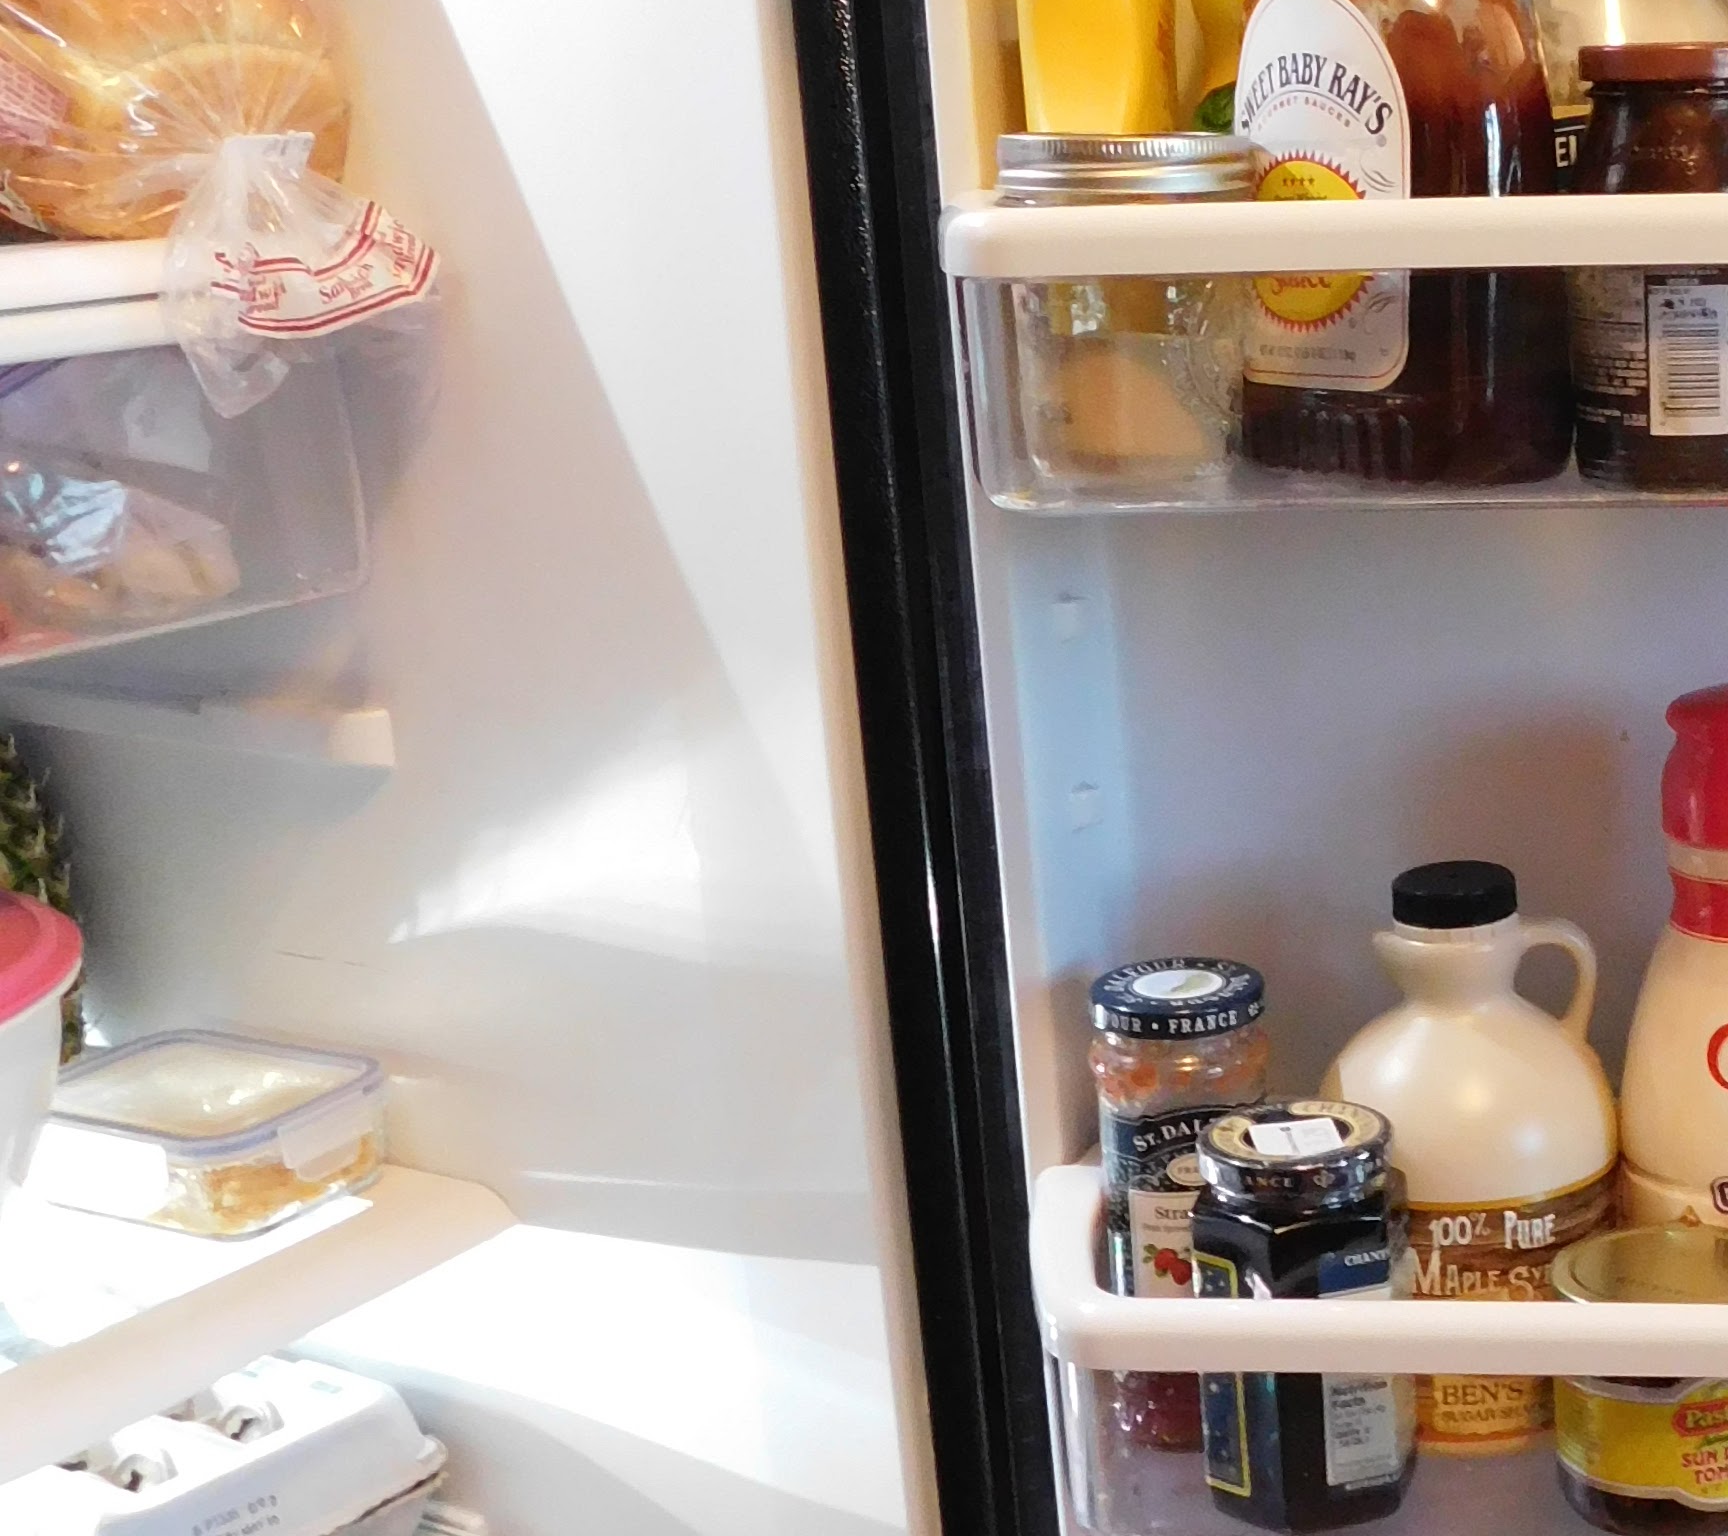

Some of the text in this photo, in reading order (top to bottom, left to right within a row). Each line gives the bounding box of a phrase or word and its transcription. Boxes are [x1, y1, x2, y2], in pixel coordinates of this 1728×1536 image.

[1277, 52, 1328, 89] BABY
[1328, 61, 1394, 135] RAY'S
[1167, 1009, 1239, 1035] FRANCE
[1429, 1211, 1491, 1252] 100%
[1441, 1381, 1525, 1406] BEN'S
